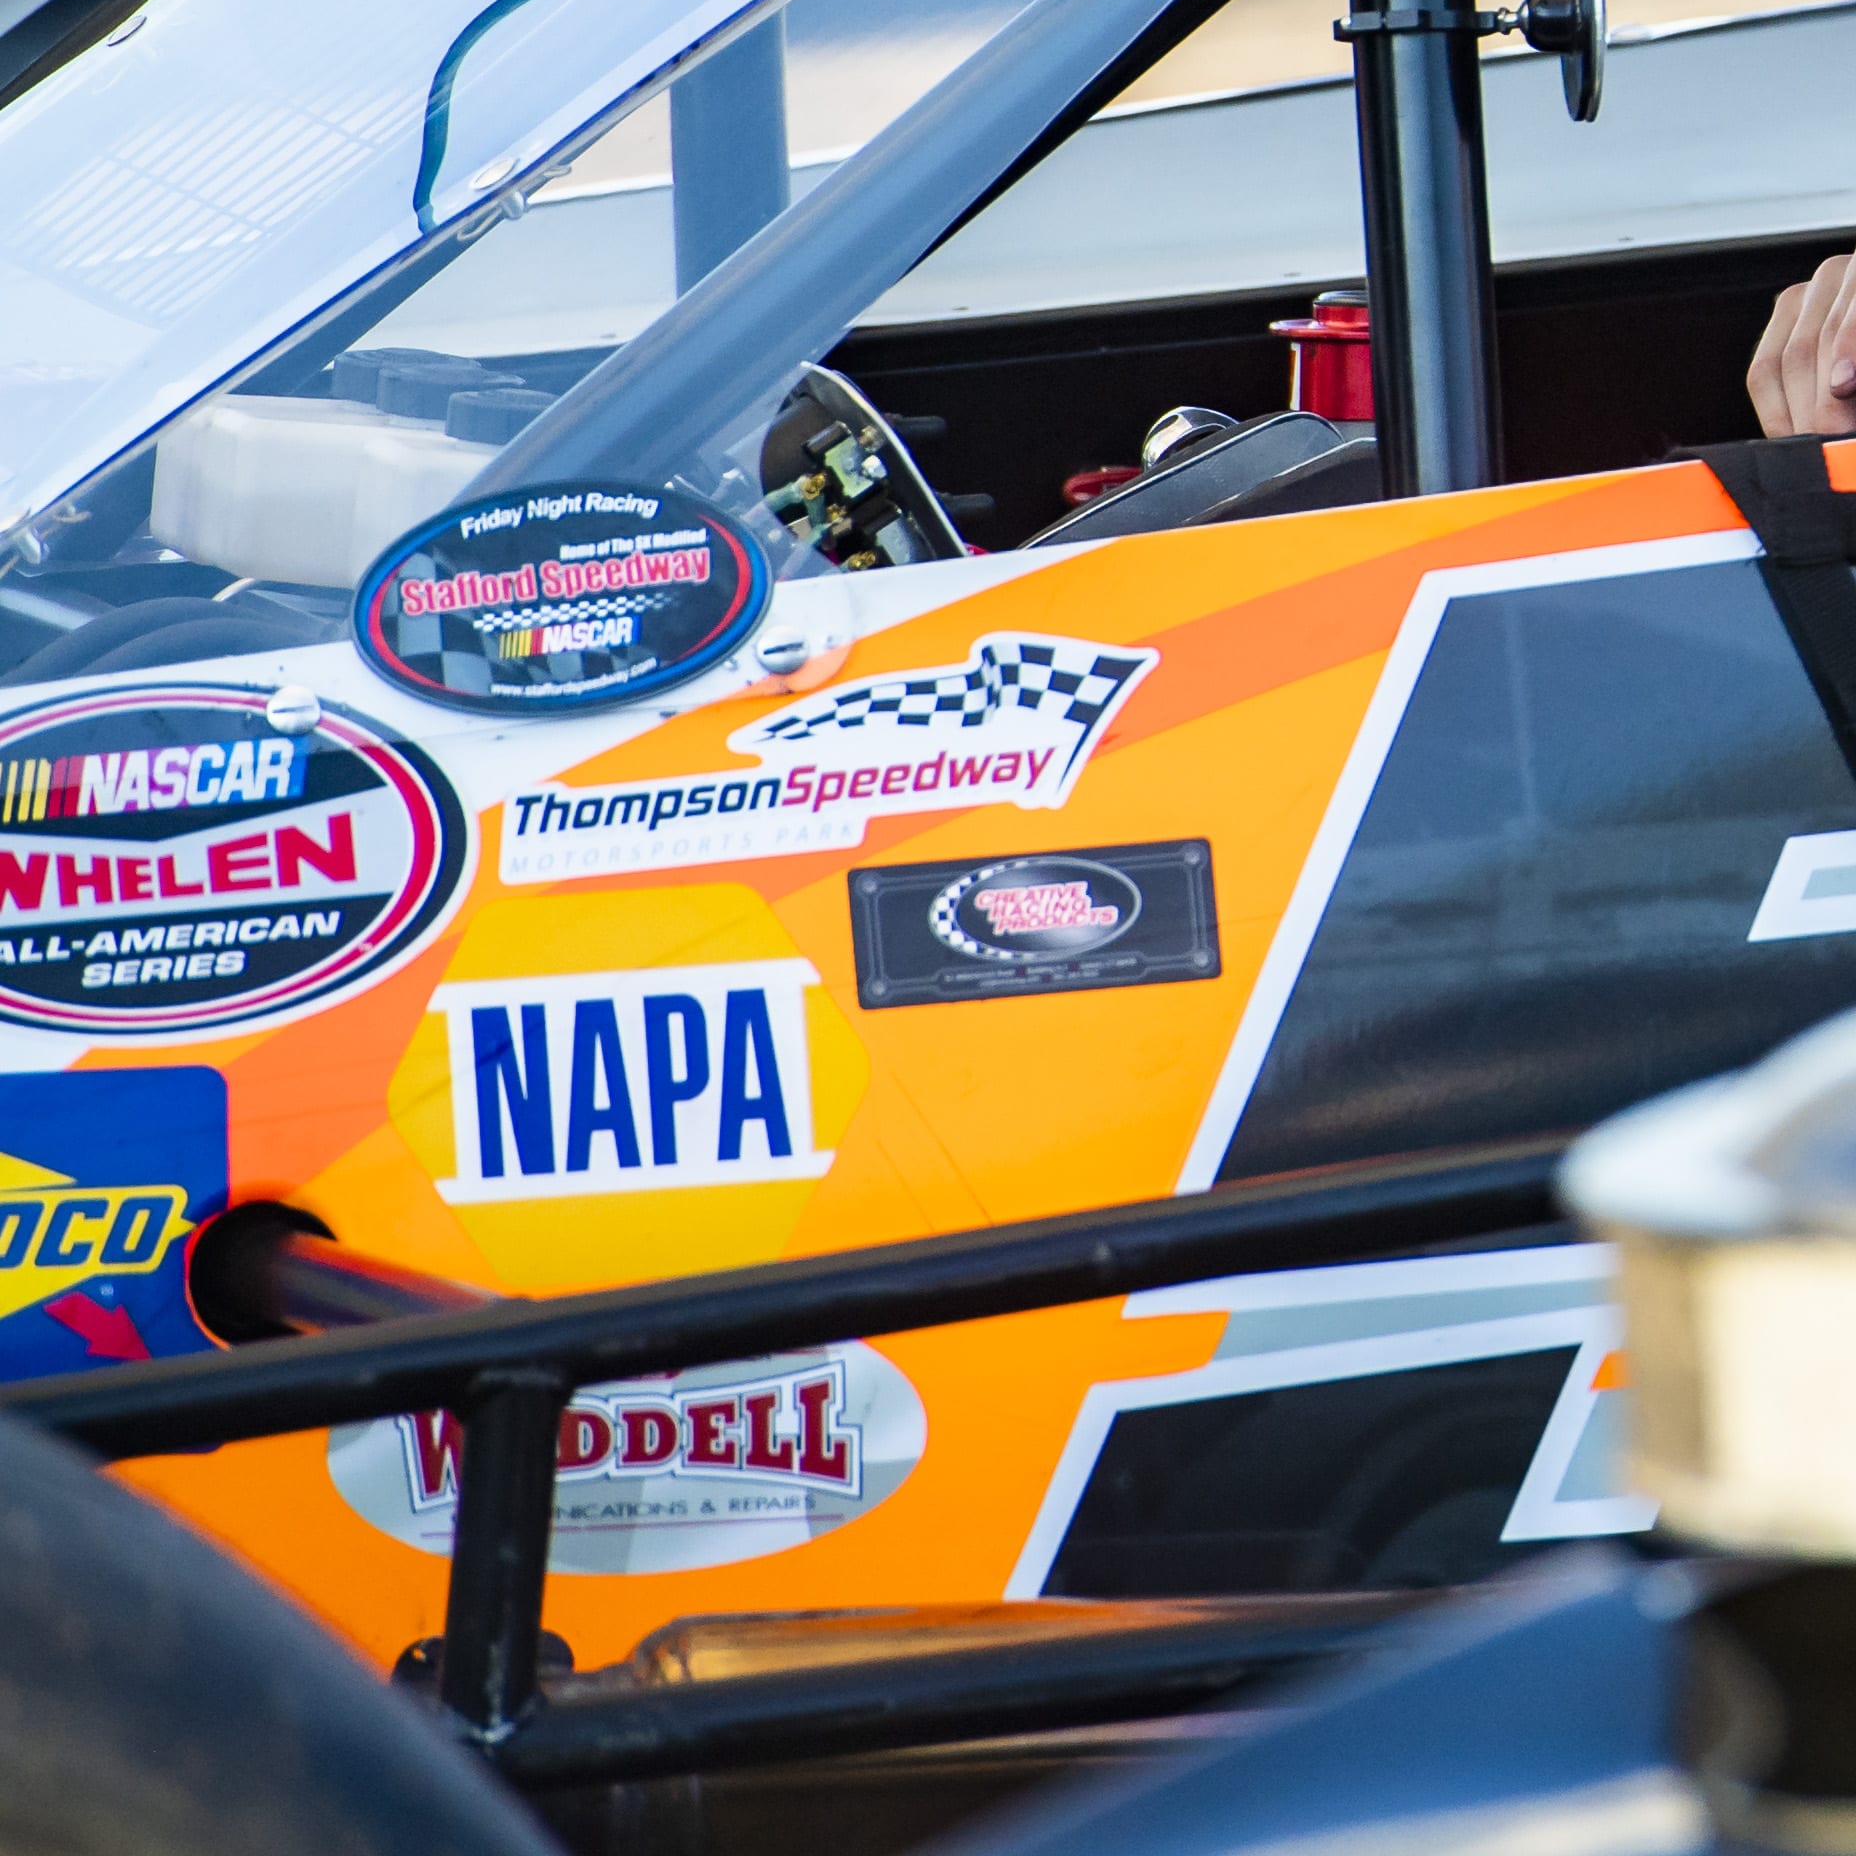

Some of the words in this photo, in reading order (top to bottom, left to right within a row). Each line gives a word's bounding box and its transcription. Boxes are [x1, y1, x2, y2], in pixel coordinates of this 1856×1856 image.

[460, 505, 523, 541] Friday
[527, 495, 583, 521] Night
[585, 492, 659, 520] Racing
[401, 562, 538, 616] Stafford
[538, 546, 711, 599] Speedway
[541, 616, 634, 654] NASCAR
[78, 736, 297, 817] NASCAR
[776, 821, 854, 843] PARK
[0, 811, 359, 913] WHELEN
[974, 882, 1088, 910] CREATIVE
[993, 906, 1118, 935] PRODUCTS
[82, 950, 247, 989] SERIES
[470, 987, 794, 1178] NAPA
[403, 1370, 856, 1502] WDDELL
[700, 1498, 716, 1515] &
